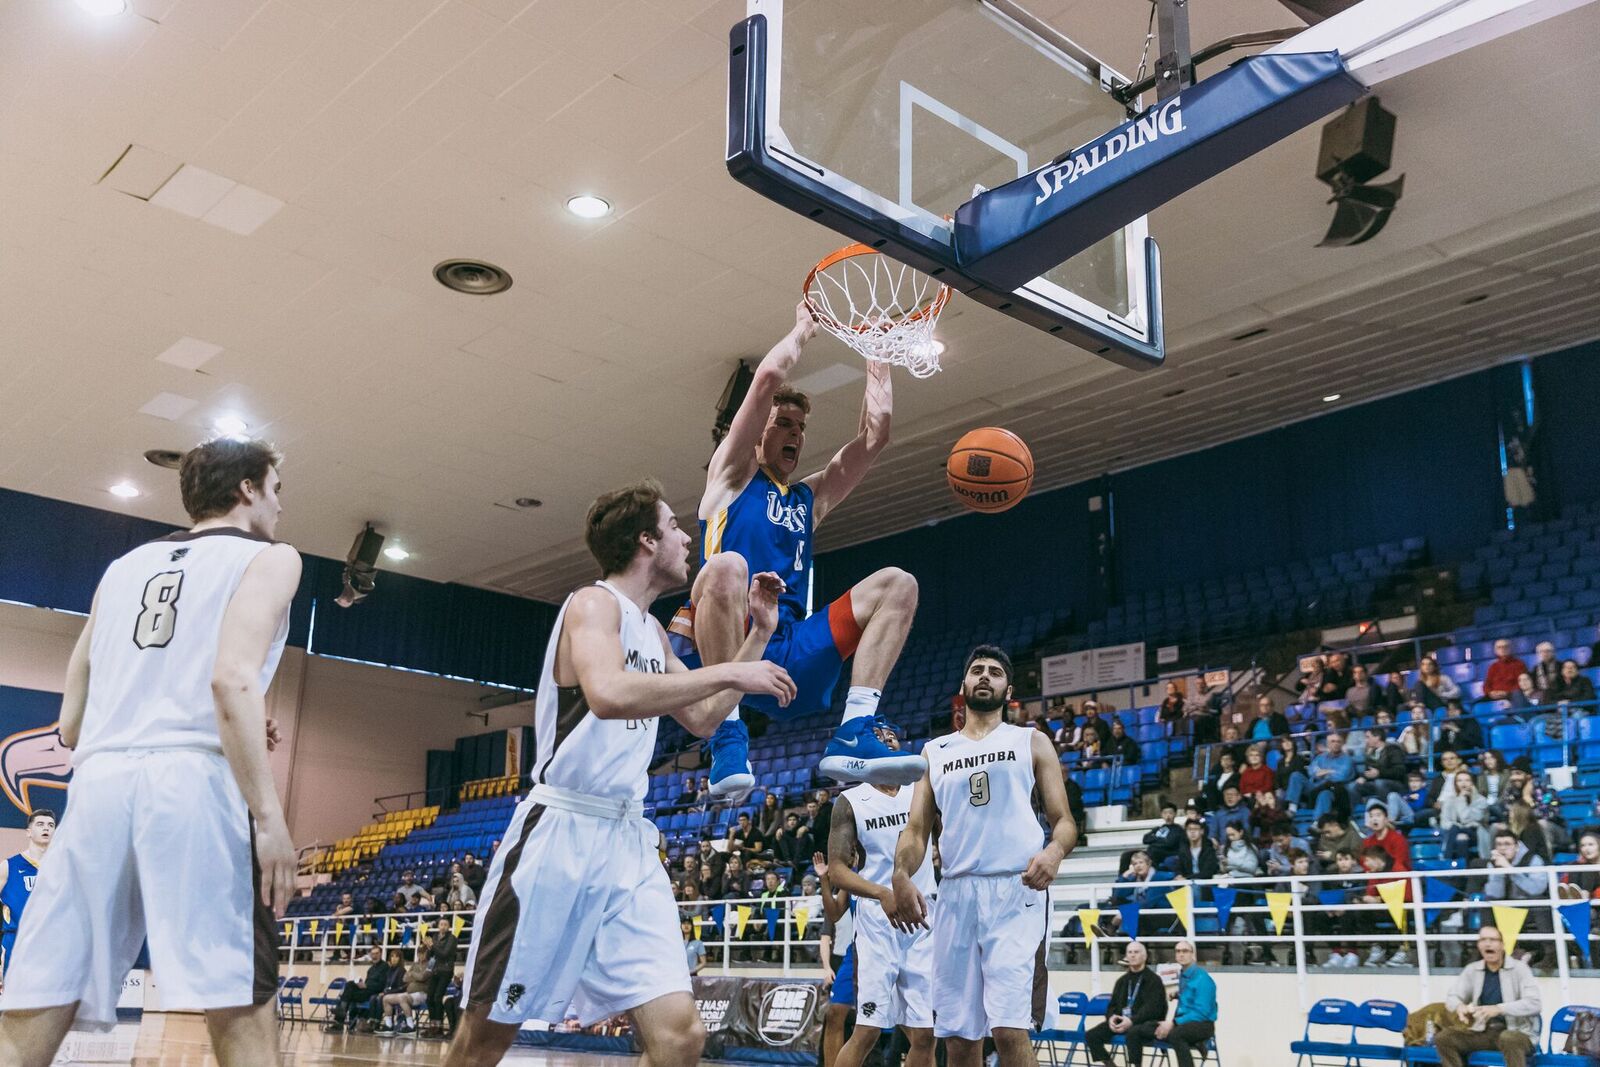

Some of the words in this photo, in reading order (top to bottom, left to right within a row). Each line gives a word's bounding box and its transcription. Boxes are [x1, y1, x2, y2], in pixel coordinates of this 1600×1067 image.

[1036, 96, 1182, 206] SPALDING
[133, 570, 184, 650] 8
[943, 751, 1017, 775] MANITOBA
[969, 770, 991, 807] 9
[702, 999, 730, 1011] NASH
